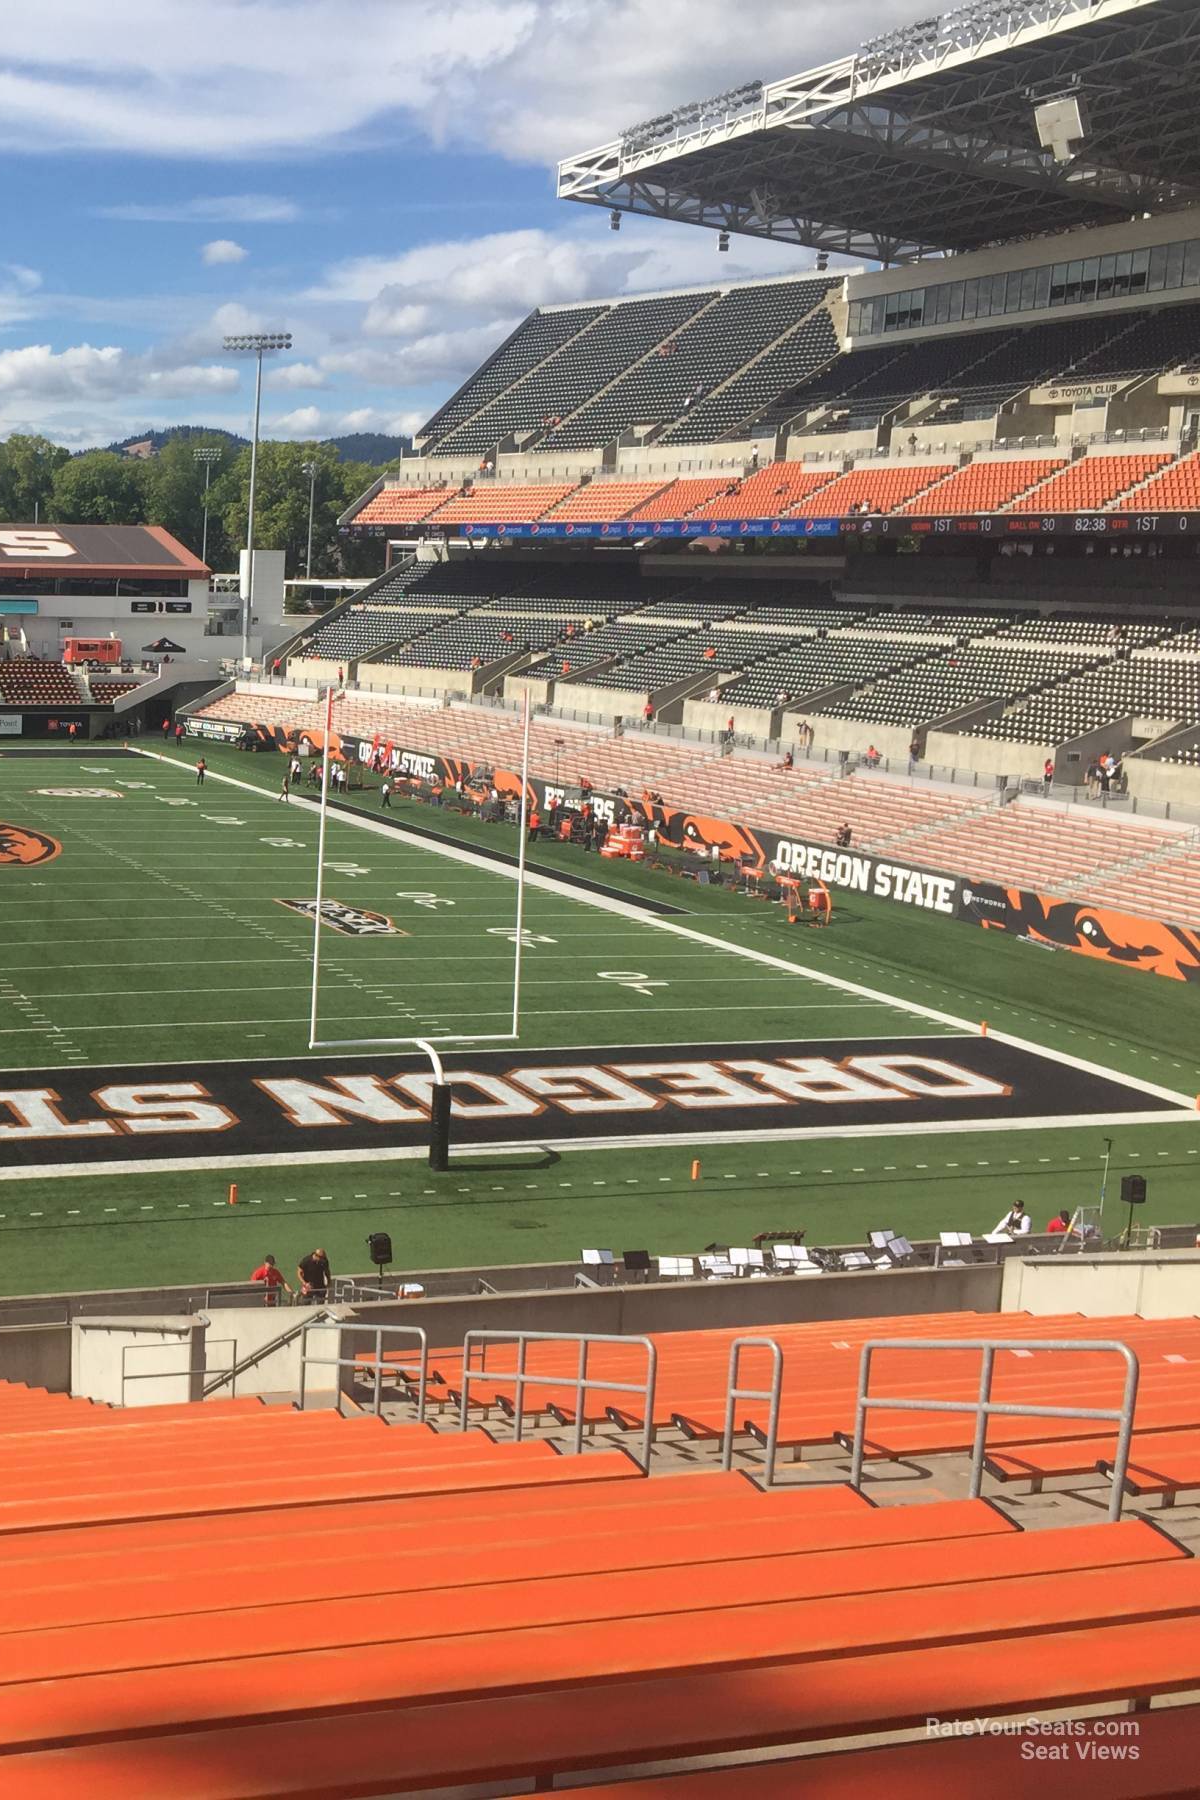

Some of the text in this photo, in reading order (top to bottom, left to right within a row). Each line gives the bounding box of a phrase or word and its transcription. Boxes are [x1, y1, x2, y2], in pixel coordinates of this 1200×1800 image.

[1060, 384, 1117, 398] TOYOTA CLUB
[933, 519, 952, 532] 1ST
[980, 519, 992, 532] 10
[1009, 521, 1027, 531] BALL
[1042, 518, 1056, 531] 30
[1074, 518, 1106, 531] 82:38
[1135, 516, 1159, 531] 1ST
[1179, 516, 1188, 531] 0
[259, 836, 307, 848] 50
[776, 840, 956, 914] OREGON STATE
[396, 891, 456, 906] 30
[597, 970, 671, 987] 10
[253, 1054, 1013, 1127] OREGON
